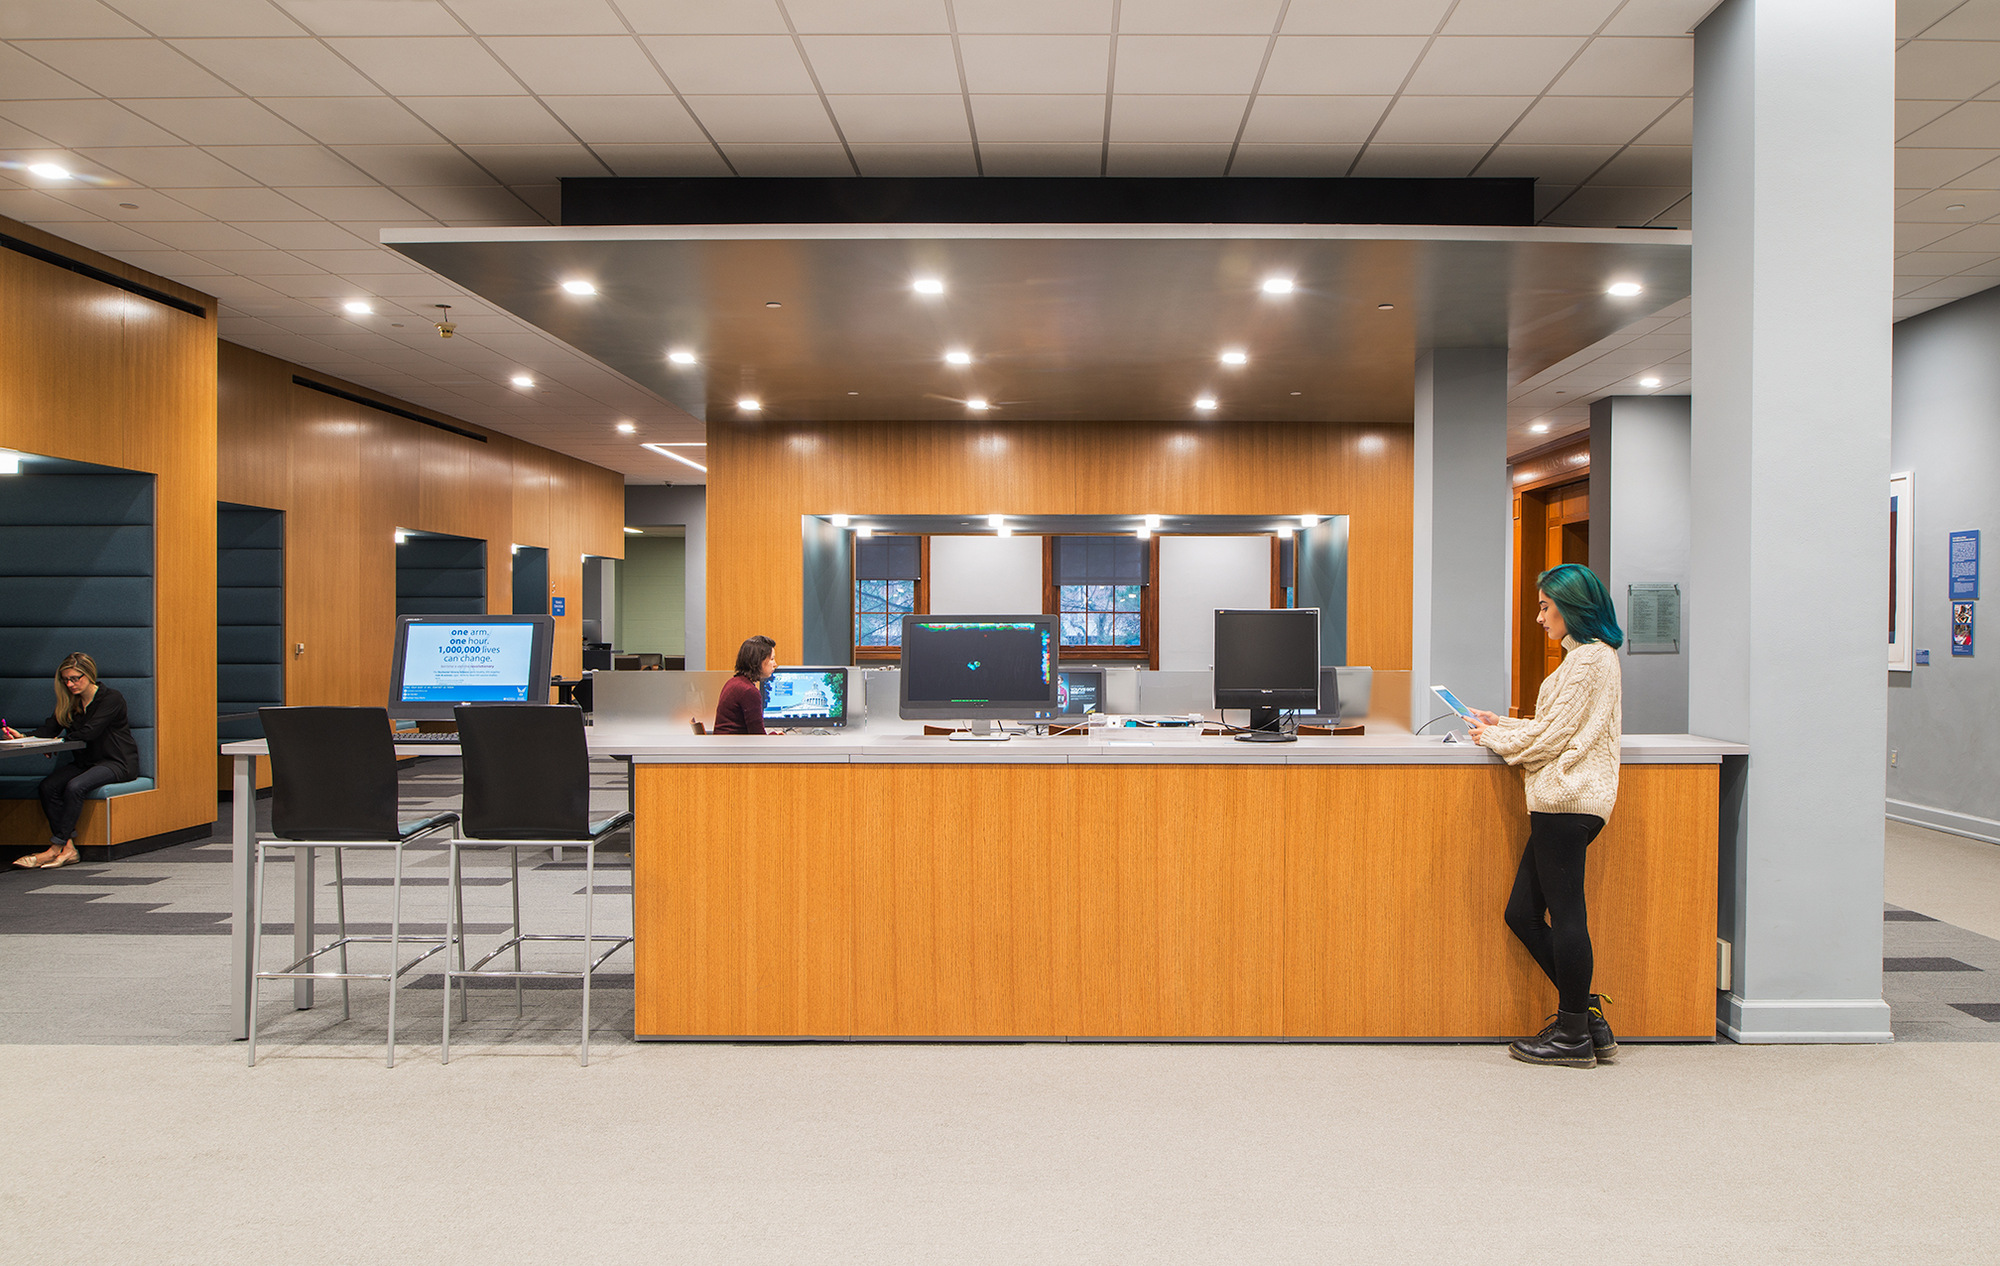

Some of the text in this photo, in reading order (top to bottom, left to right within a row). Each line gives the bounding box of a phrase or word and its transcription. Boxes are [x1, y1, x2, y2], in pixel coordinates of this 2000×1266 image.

[468, 637, 490, 645] hour.
[438, 646, 501, 654] 1,000,000 lives
[460, 654, 493, 664] change.
